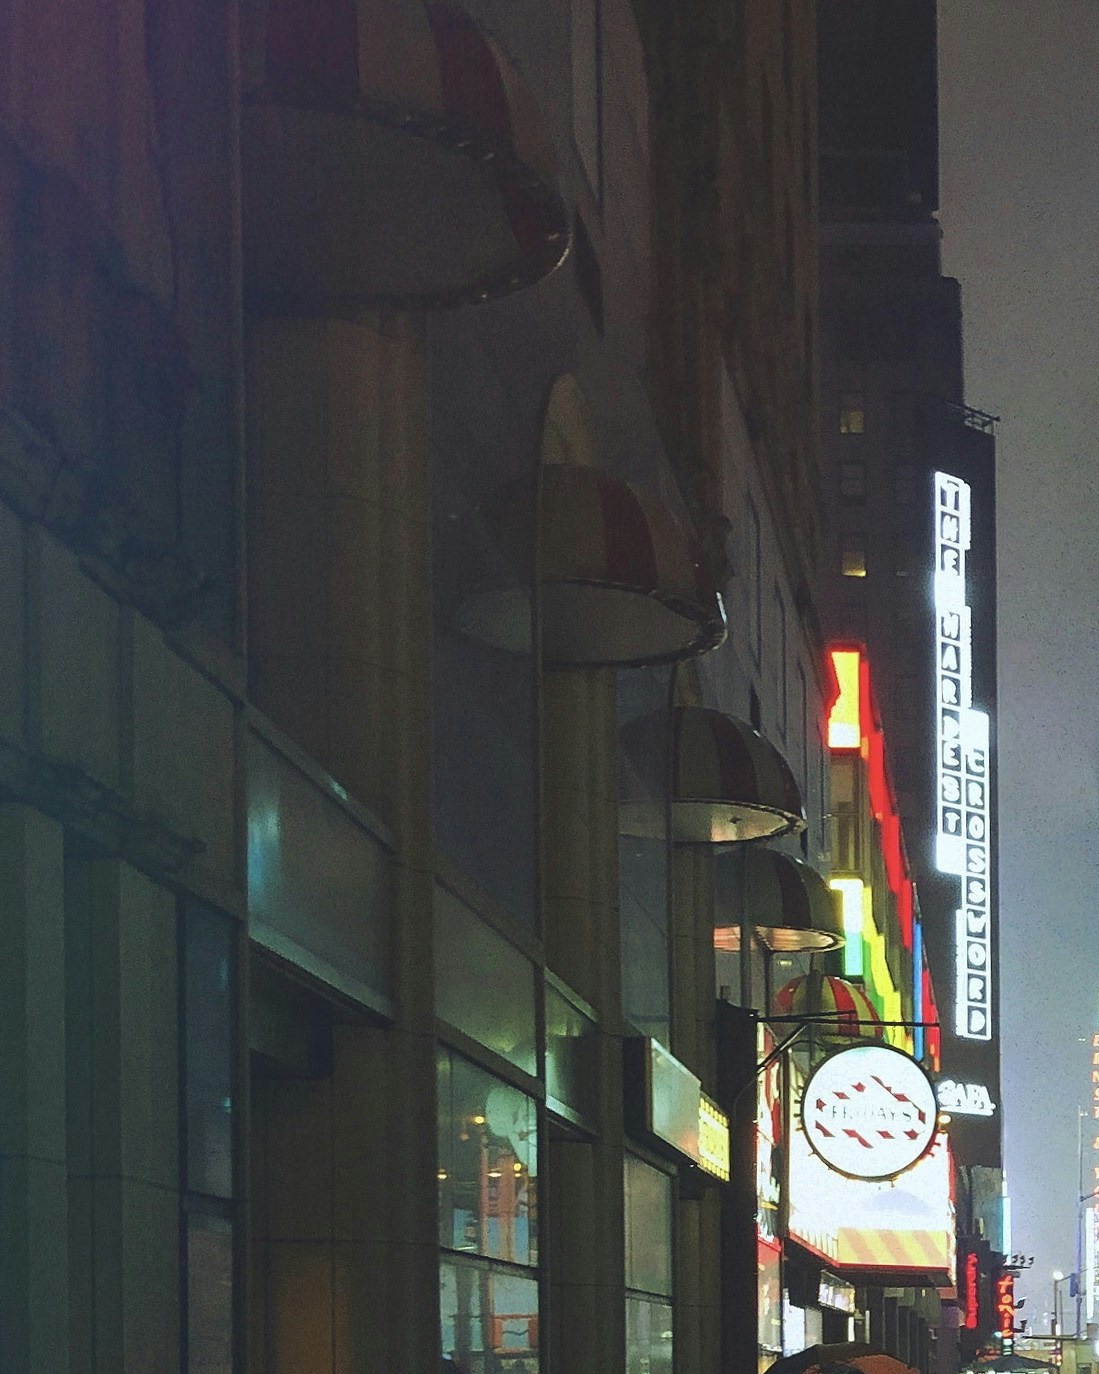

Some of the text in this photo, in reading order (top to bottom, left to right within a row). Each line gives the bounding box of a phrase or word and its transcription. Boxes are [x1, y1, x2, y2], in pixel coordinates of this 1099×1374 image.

[940, 481, 960, 576] THE
[941, 604, 961, 833] HARDEST
[967, 750, 986, 1033] CROSSWORD
